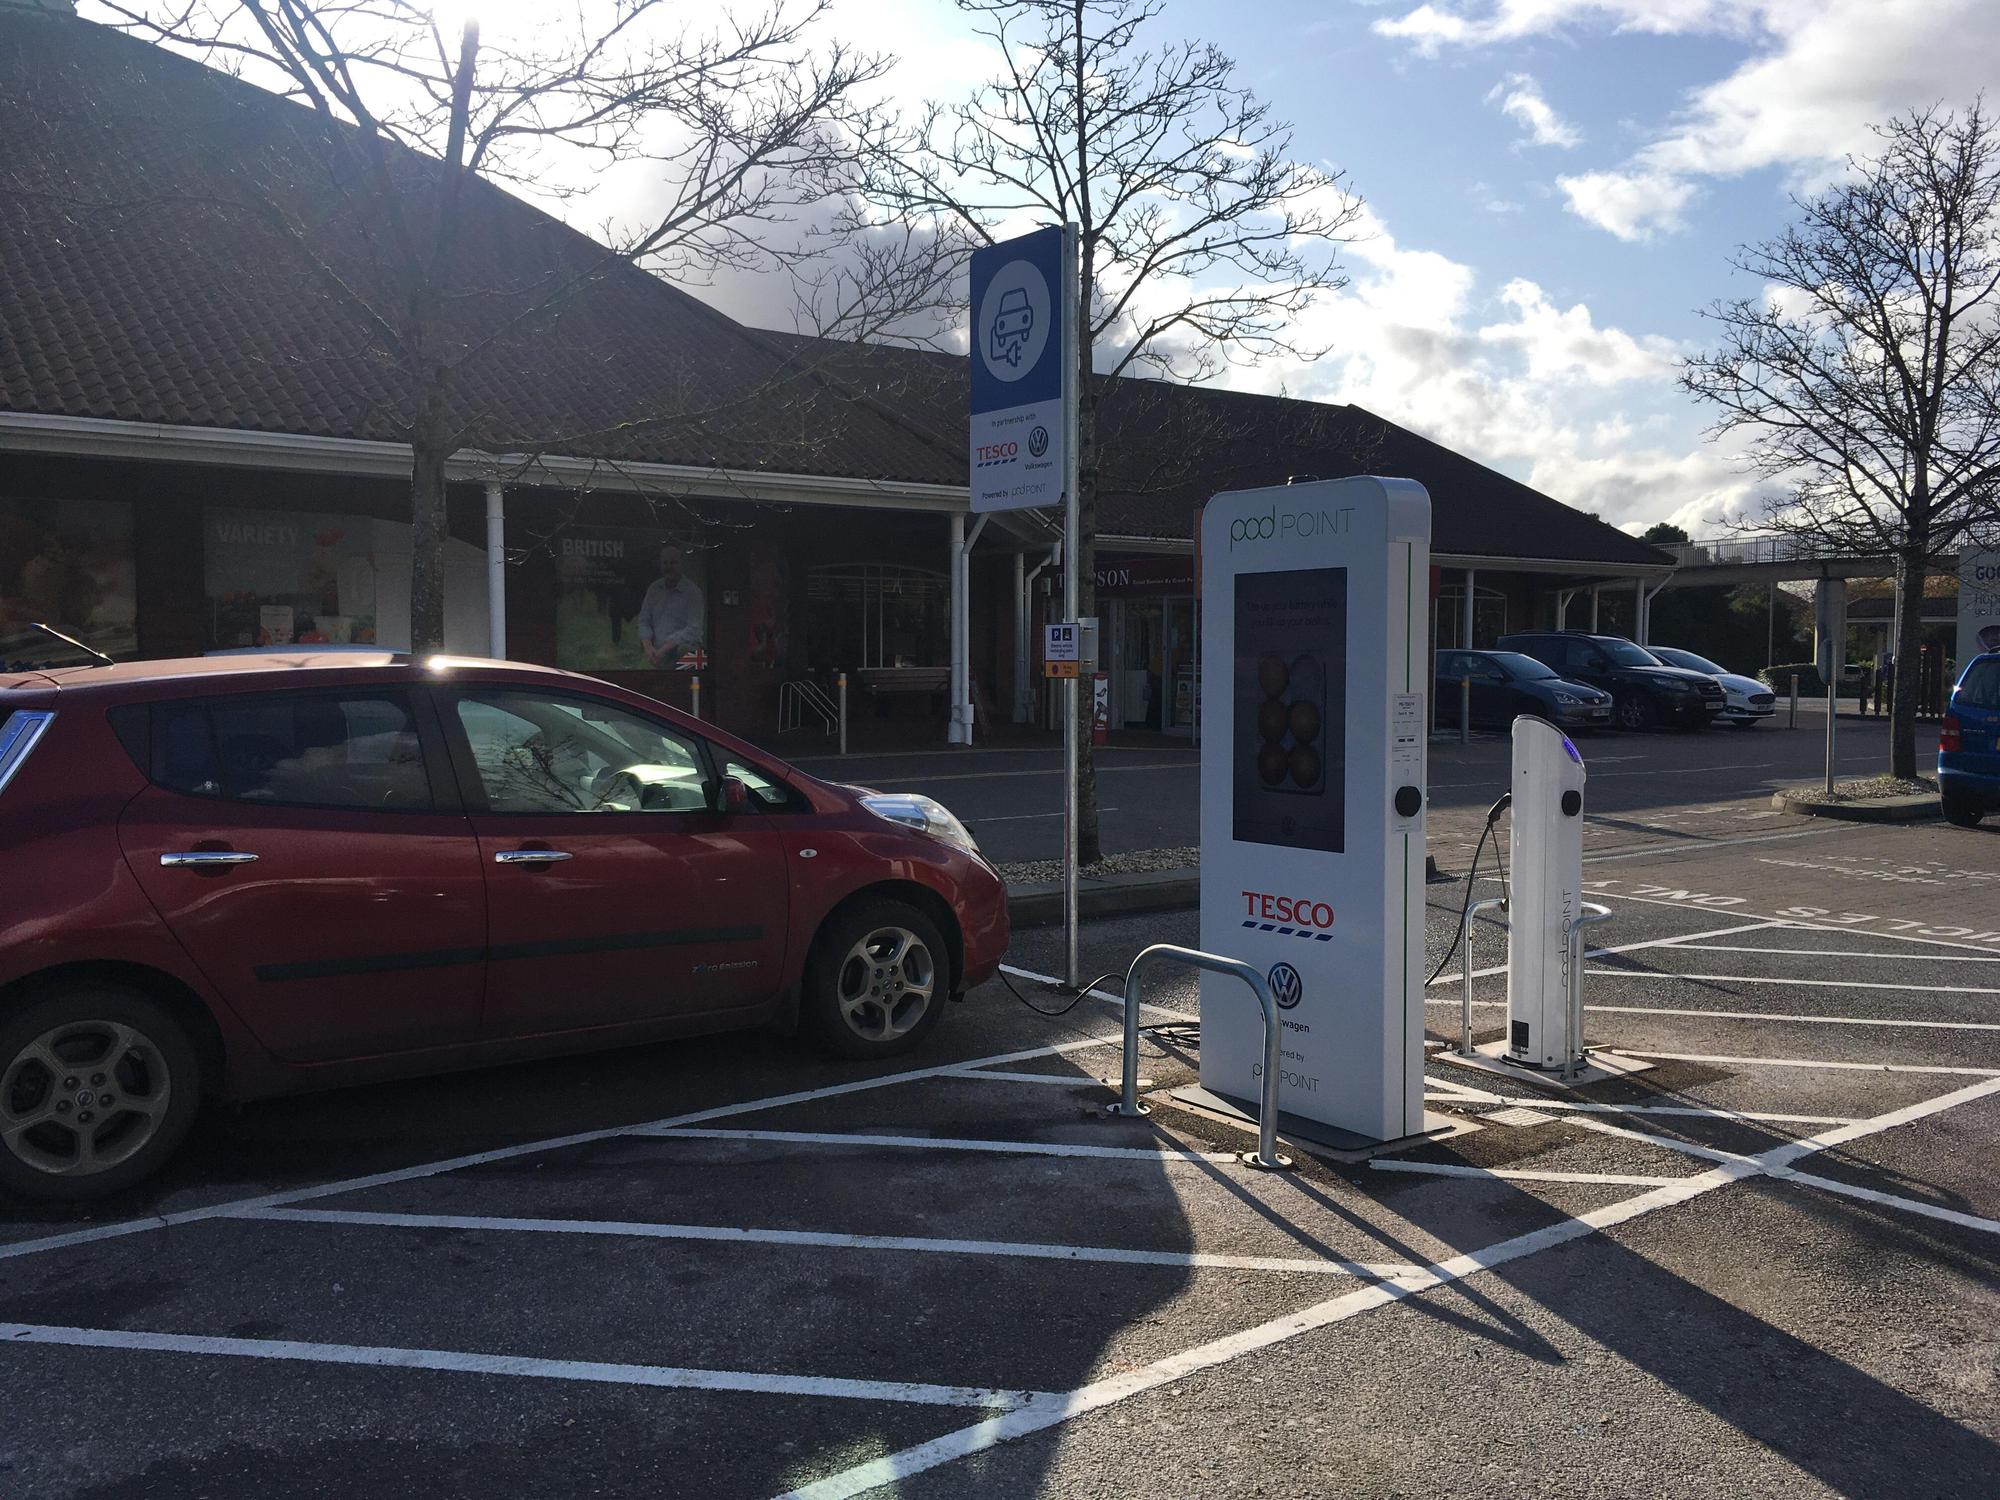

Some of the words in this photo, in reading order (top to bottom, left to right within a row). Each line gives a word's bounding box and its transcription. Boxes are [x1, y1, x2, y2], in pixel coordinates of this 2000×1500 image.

[976, 441, 1018, 461] TESCO
[1024, 461, 1053, 471] Volkswagen
[217, 524, 301, 546] VARIETY
[561, 537, 625, 559] BRITISH
[1975, 565, 2000, 581] GO
[1241, 890, 1335, 929] TESCO
[1296, 1051, 1305, 1063] by
